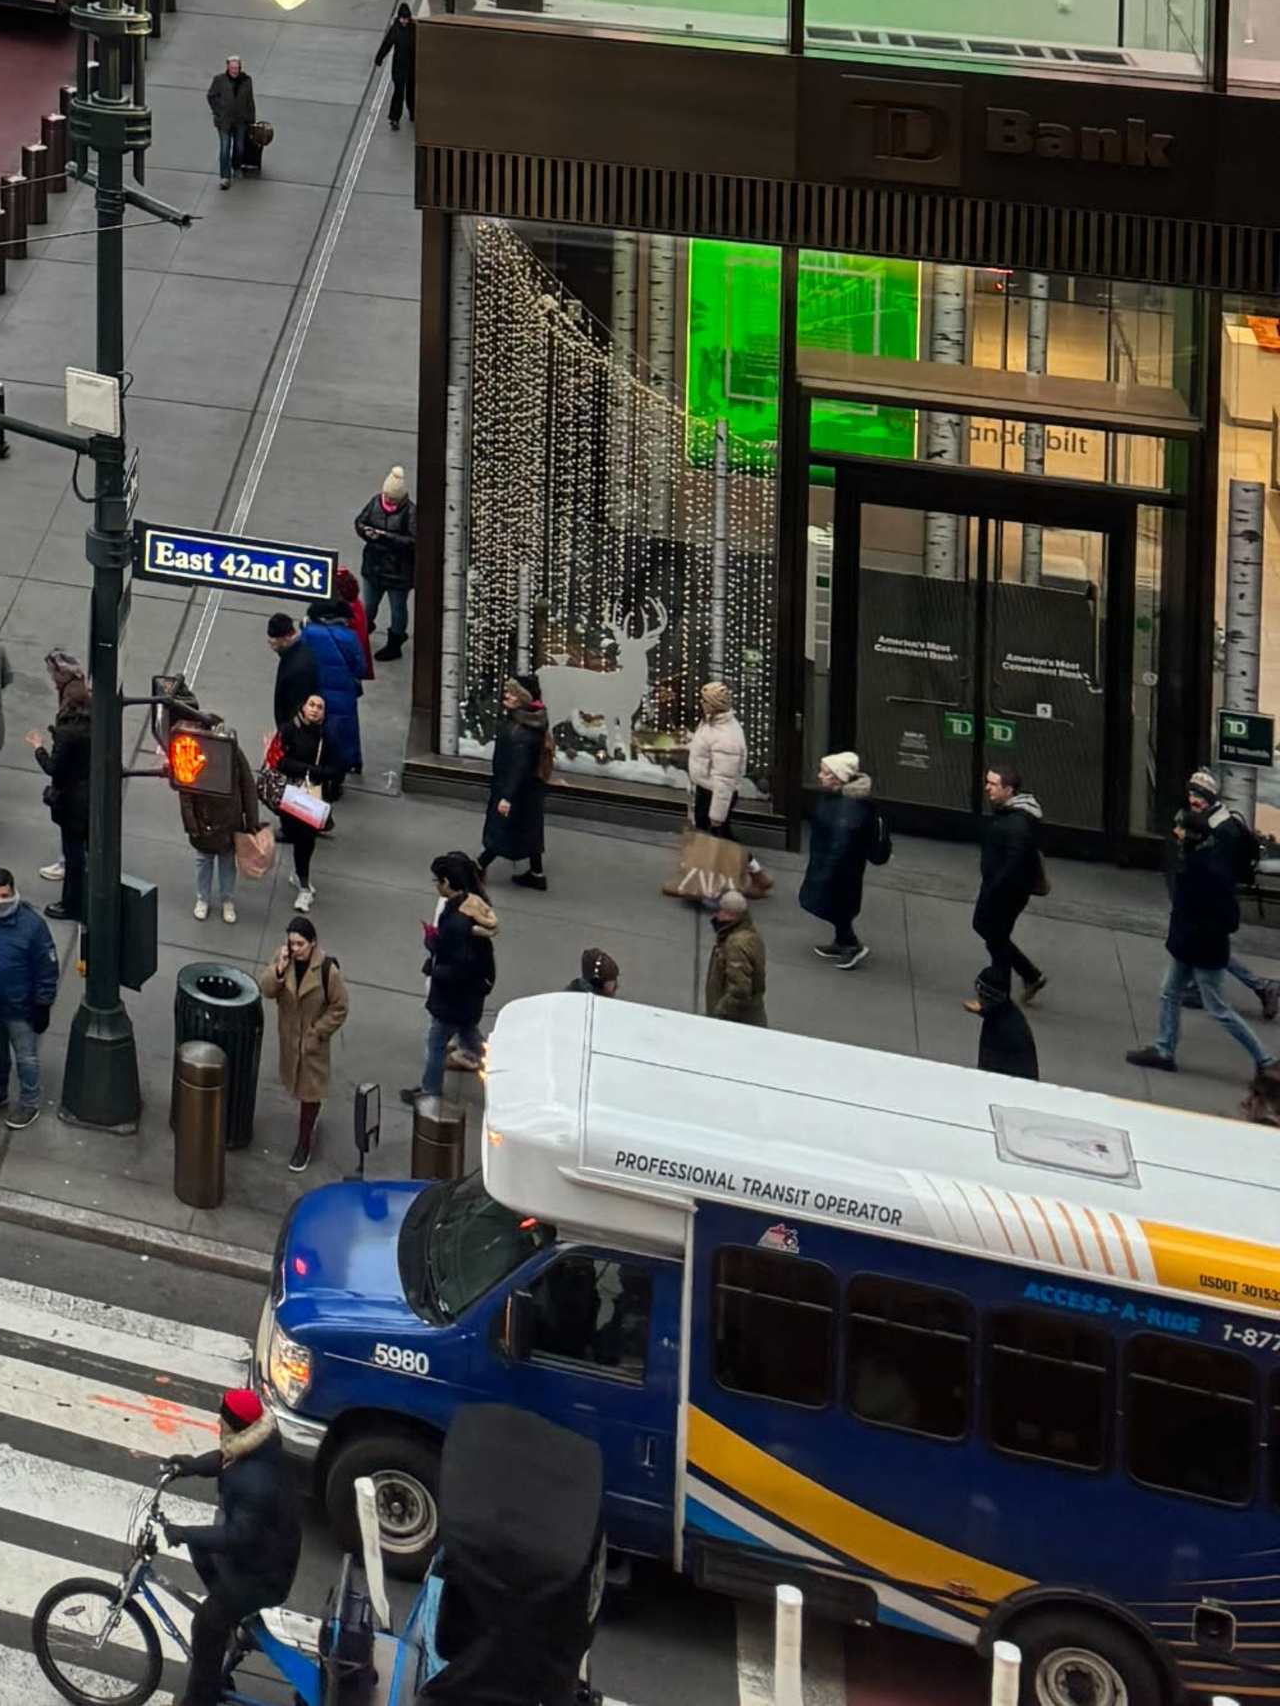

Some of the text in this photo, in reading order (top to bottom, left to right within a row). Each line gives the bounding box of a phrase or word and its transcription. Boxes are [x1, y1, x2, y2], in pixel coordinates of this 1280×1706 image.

[986, 107, 1175, 167] Bank
[155, 541, 323, 590] East 42nd St
[946, 718, 973, 735] TD
[986, 724, 1013, 742] TD
[1225, 719, 1247, 735] TD
[615, 1151, 903, 1227] PROFESSIONAL TRANSIT OPERATOR
[1199, 1274, 1280, 1304] USDOT 30153
[1023, 1282, 1201, 1334] ACCESS-A-RIDE
[374, 1342, 429, 1375] 5980
